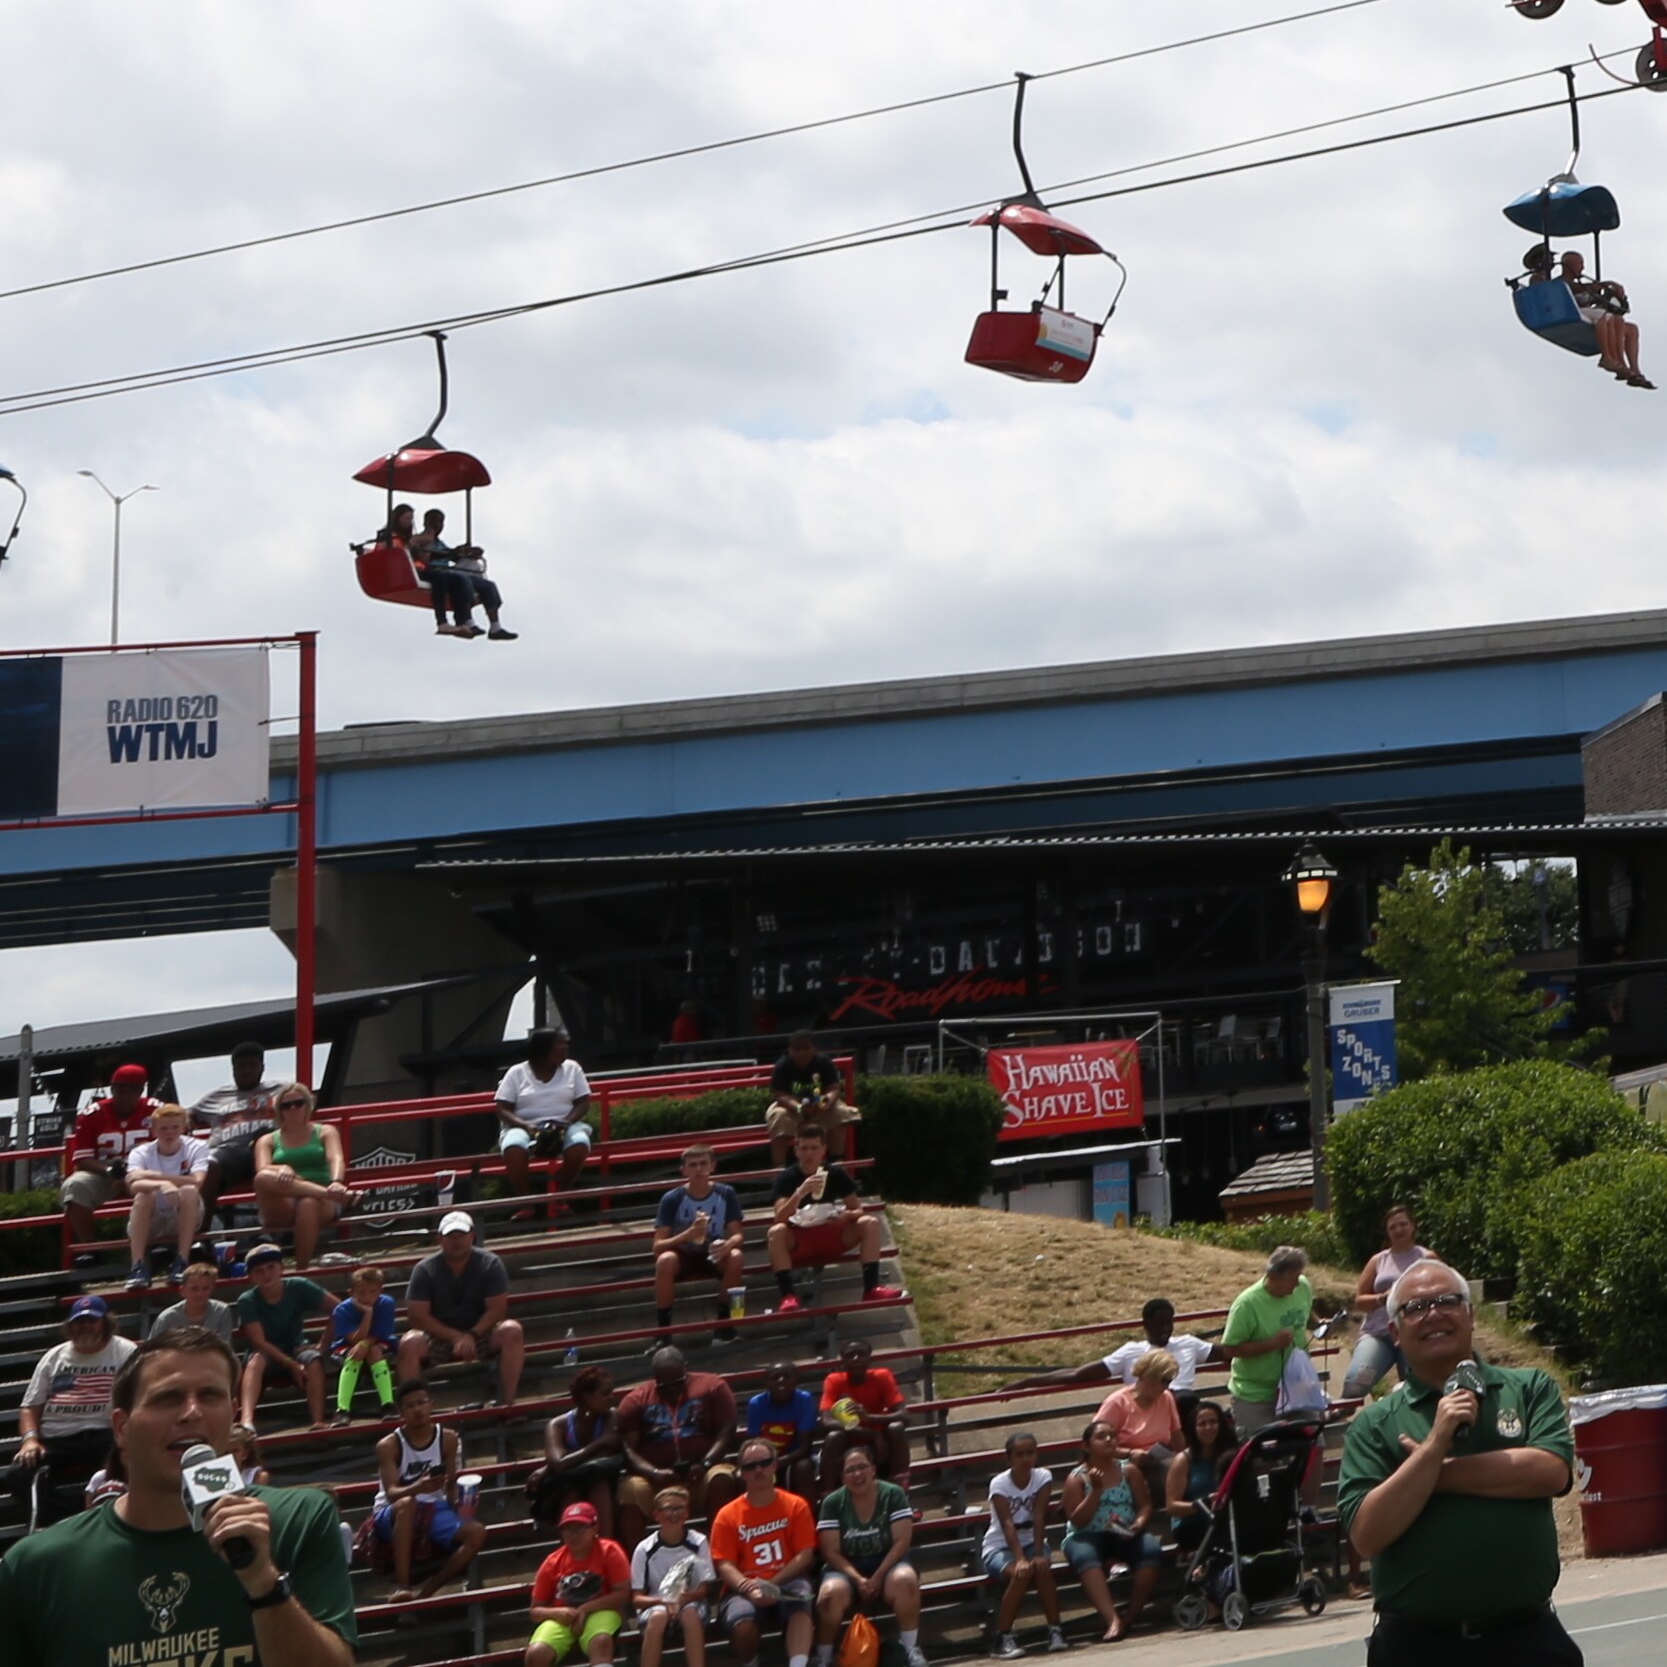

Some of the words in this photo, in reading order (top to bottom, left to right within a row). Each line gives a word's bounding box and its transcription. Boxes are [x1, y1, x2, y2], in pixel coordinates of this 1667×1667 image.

[107, 696, 172, 724] RADIO
[176, 694, 218, 721] 620
[107, 720, 218, 764] WTMJ
[1336, 1029, 1391, 1080] SPORTS
[1000, 1090, 1091, 1128] SHAVE
[1091, 1082, 1130, 1118] ICE
[96, 1129, 150, 1161] 25
[752, 1539, 784, 1566] 31
[108, 1627, 220, 1667] MILWAUKEE
